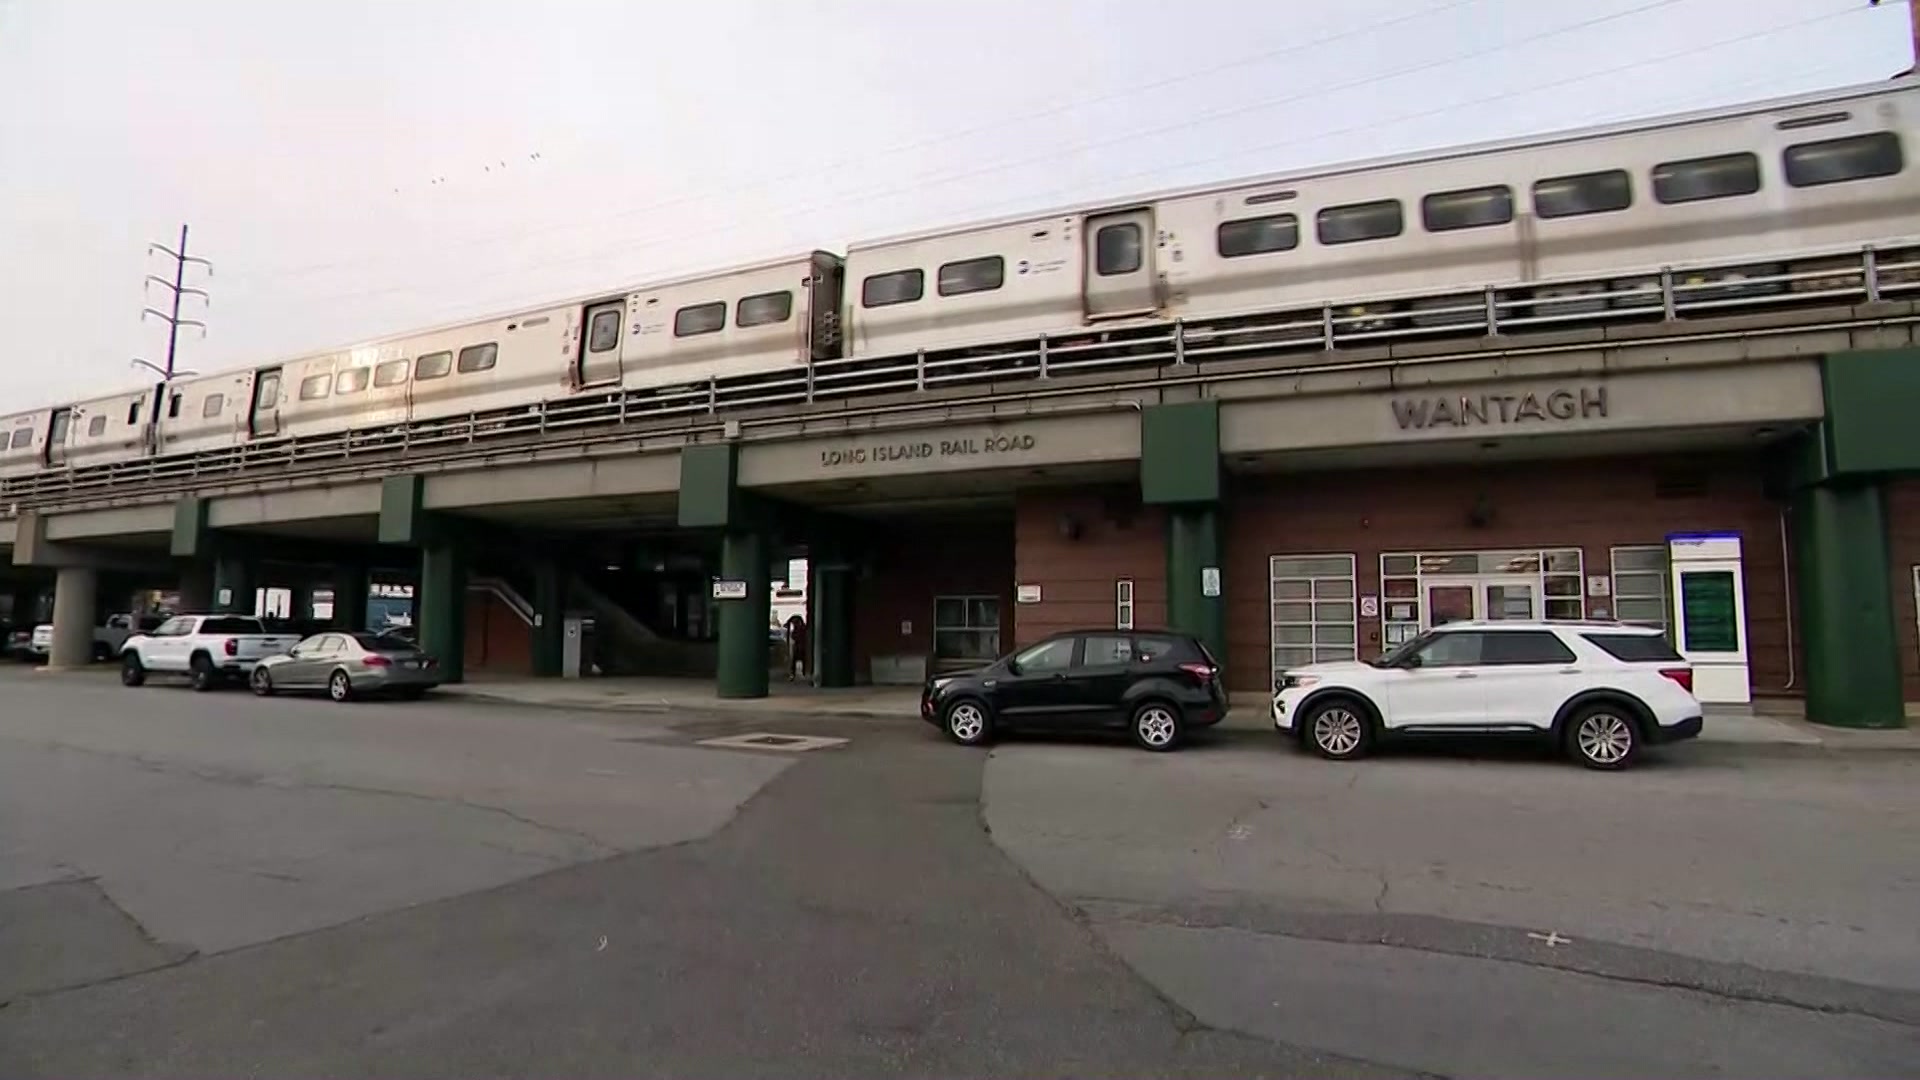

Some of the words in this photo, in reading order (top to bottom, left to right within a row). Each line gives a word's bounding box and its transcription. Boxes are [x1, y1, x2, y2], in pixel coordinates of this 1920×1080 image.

[1391, 386, 1608, 430] WANTAGH
[821, 448, 866, 467] LONG
[873, 442, 933, 461] ISLAND
[940, 439, 979, 455] RAIL
[984, 434, 1035, 453] ROAD
